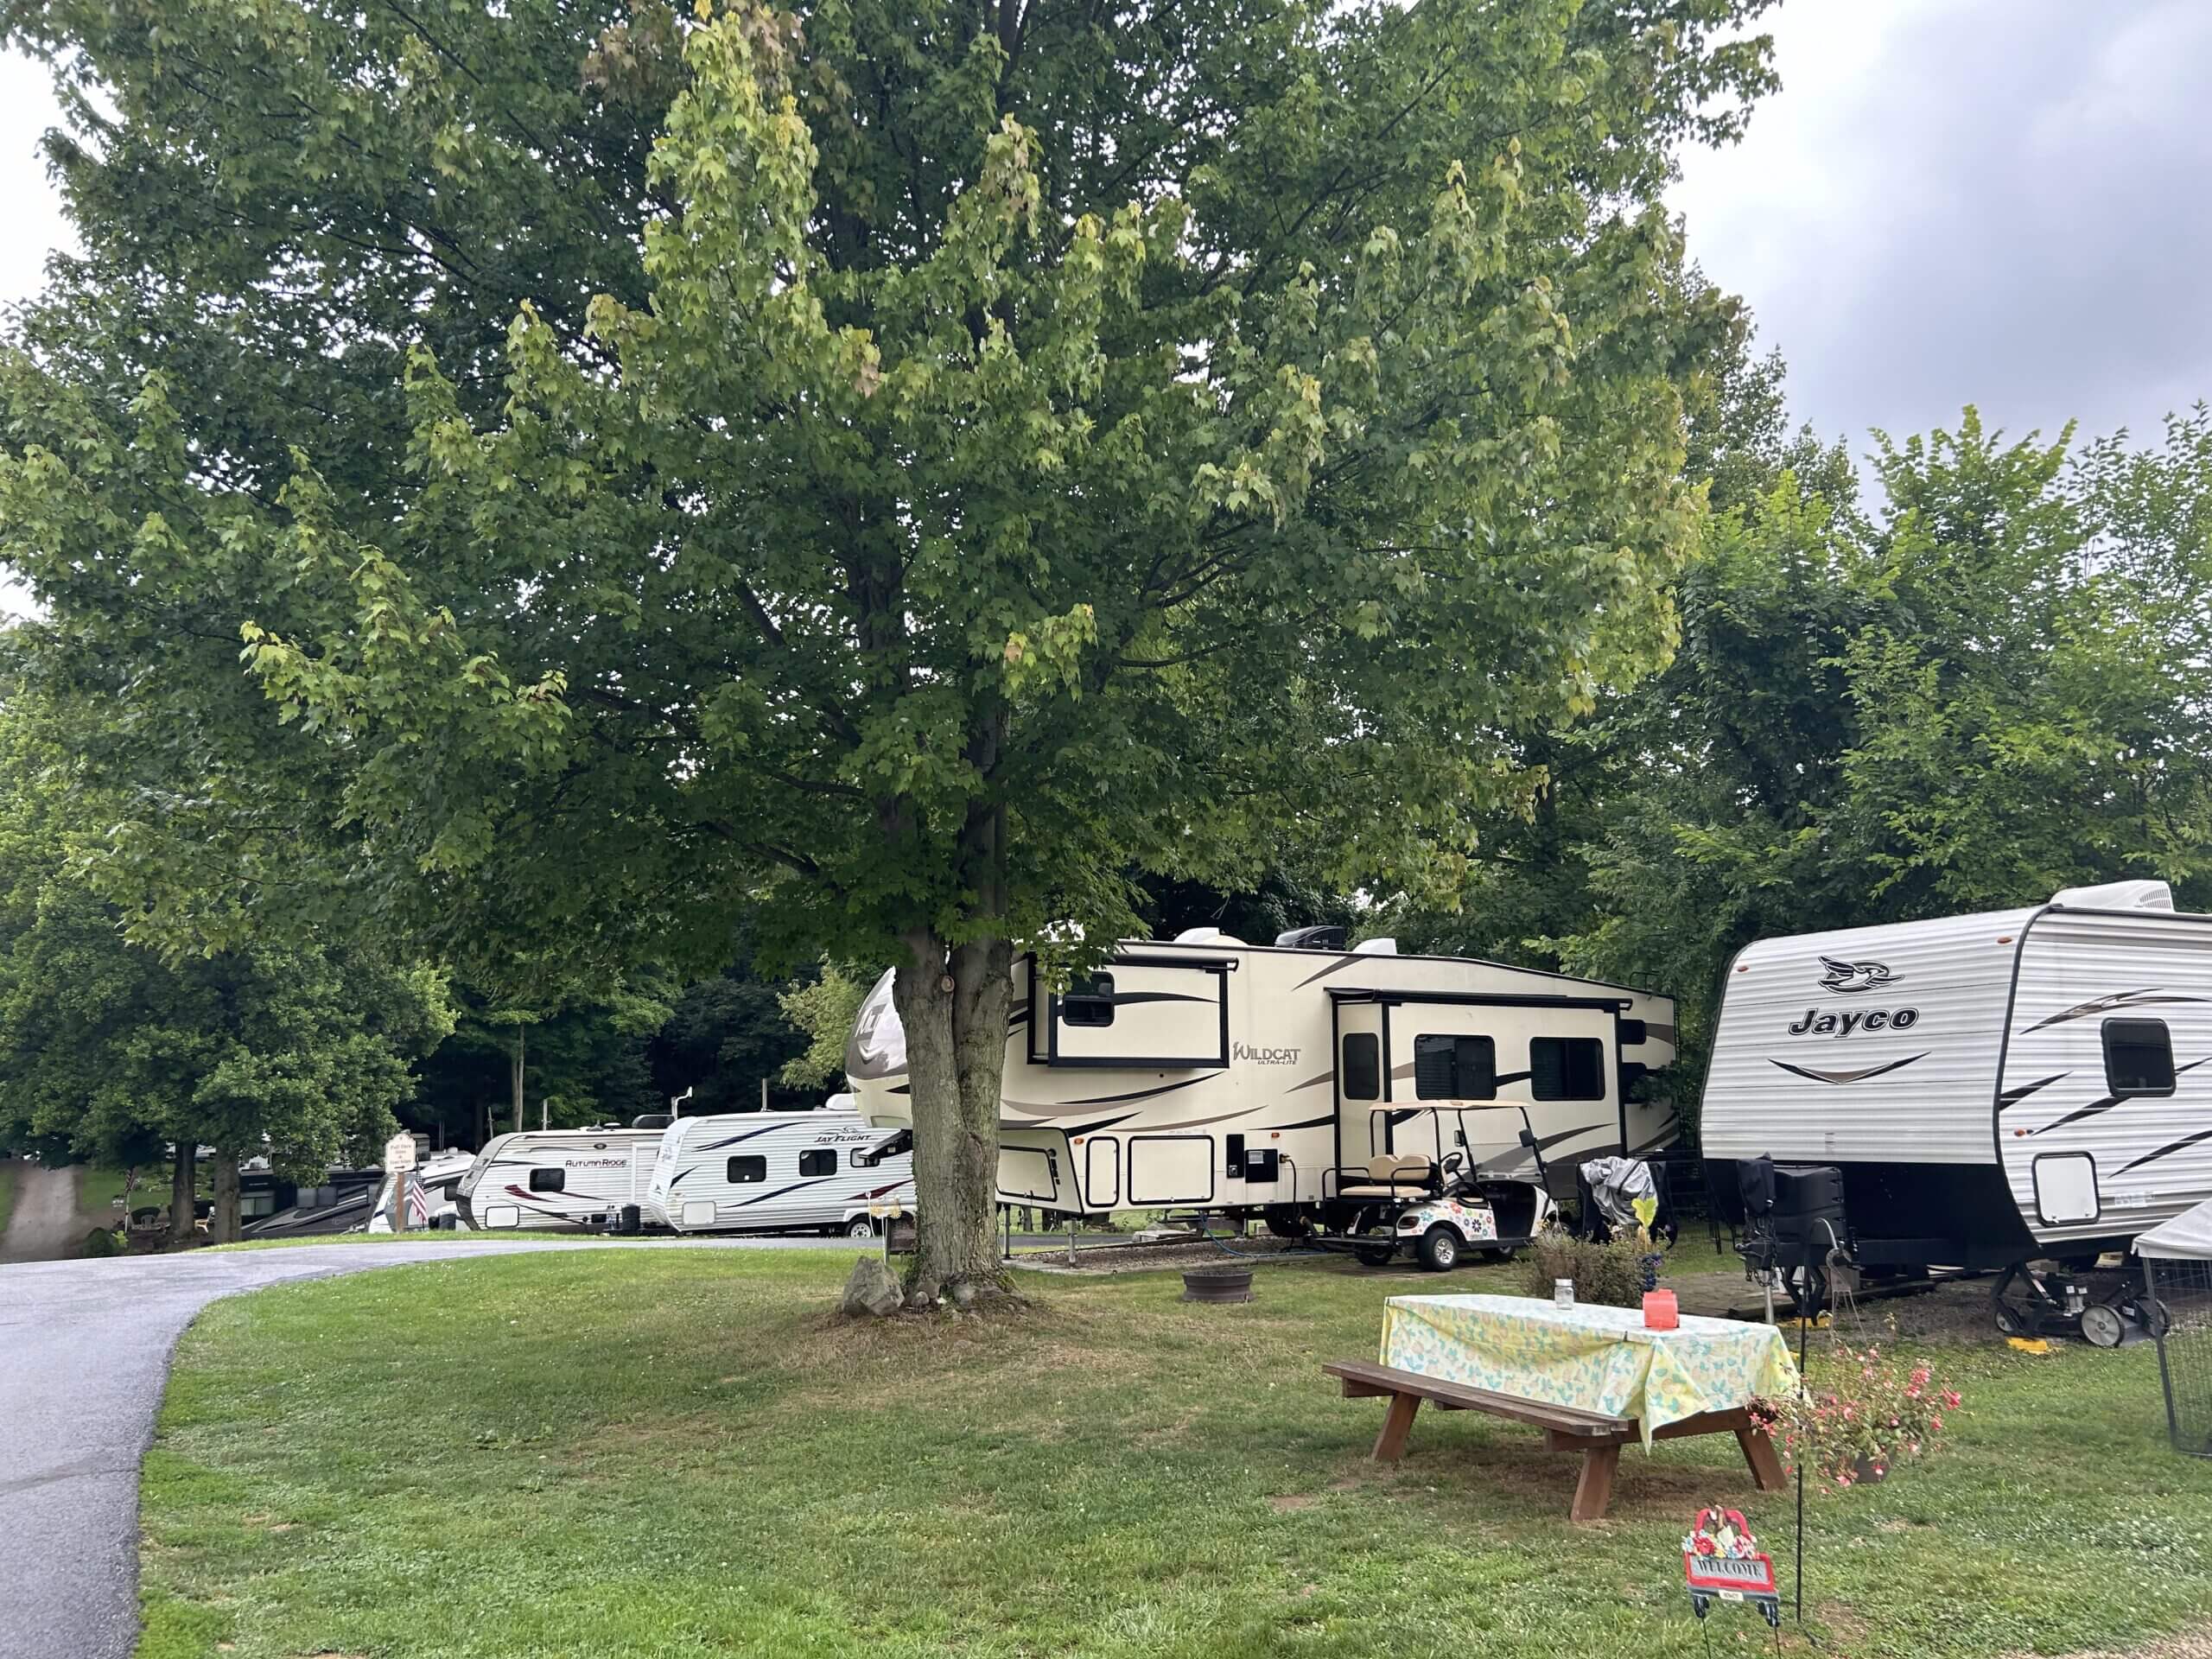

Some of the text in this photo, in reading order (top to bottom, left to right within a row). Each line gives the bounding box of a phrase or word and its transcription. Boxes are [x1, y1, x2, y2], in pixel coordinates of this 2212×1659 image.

[1788, 1007, 1920, 1038] Jayco
[1233, 1041, 1301, 1061] WILDCAT
[835, 1134, 872, 1142] FLIGHT
